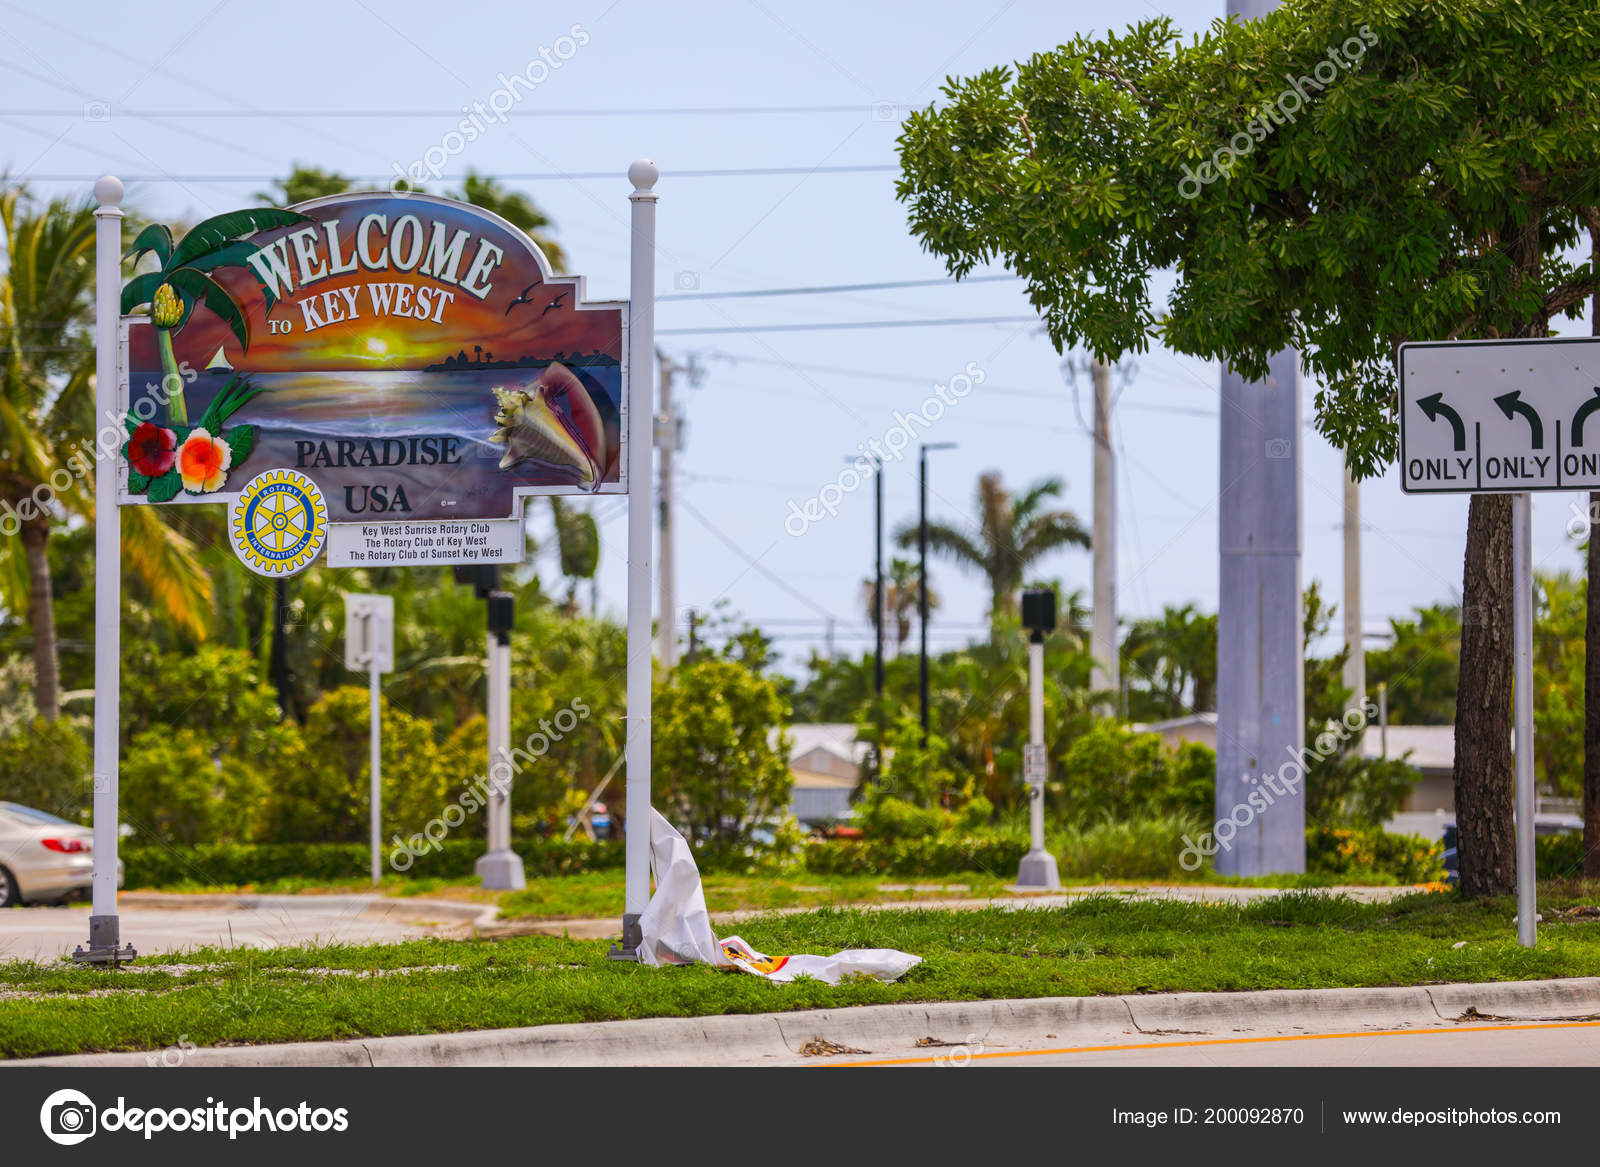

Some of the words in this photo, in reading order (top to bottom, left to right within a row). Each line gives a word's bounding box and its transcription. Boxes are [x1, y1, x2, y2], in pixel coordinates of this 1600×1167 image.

[246, 213, 504, 300] WELCOME
[268, 319, 292, 334] TO
[298, 285, 360, 332] KEY
[367, 282, 454, 324] WEST
[295, 437, 462, 467] PARADISE
[1409, 457, 1473, 480] ONLY
[1486, 456, 1550, 479] ONLY
[1564, 453, 1600, 476] ON
[262, 485, 298, 496] ROTARY
[343, 484, 412, 514] USA
[362, 526, 378, 537] Key
[381, 525, 402, 535] West
[405, 525, 437, 535] Sunrise
[440, 524, 468, 535] Rotary
[471, 524, 490, 533] Club
[250, 537, 308, 559] INTERNATIONAL
[365, 539, 381, 548] The
[384, 538, 412, 549] Rotary
[414, 537, 433, 546] Club
[436, 537, 445, 546] of
[447, 537, 462, 547] Key
[465, 536, 487, 545] West
[349, 551, 365, 560] The
[368, 550, 396, 561] Rotary
[399, 550, 417, 559] Club
[420, 549, 429, 558] of
[431, 549, 460, 558] Sunset
[462, 548, 479, 559] Key
[481, 548, 503, 557] West
